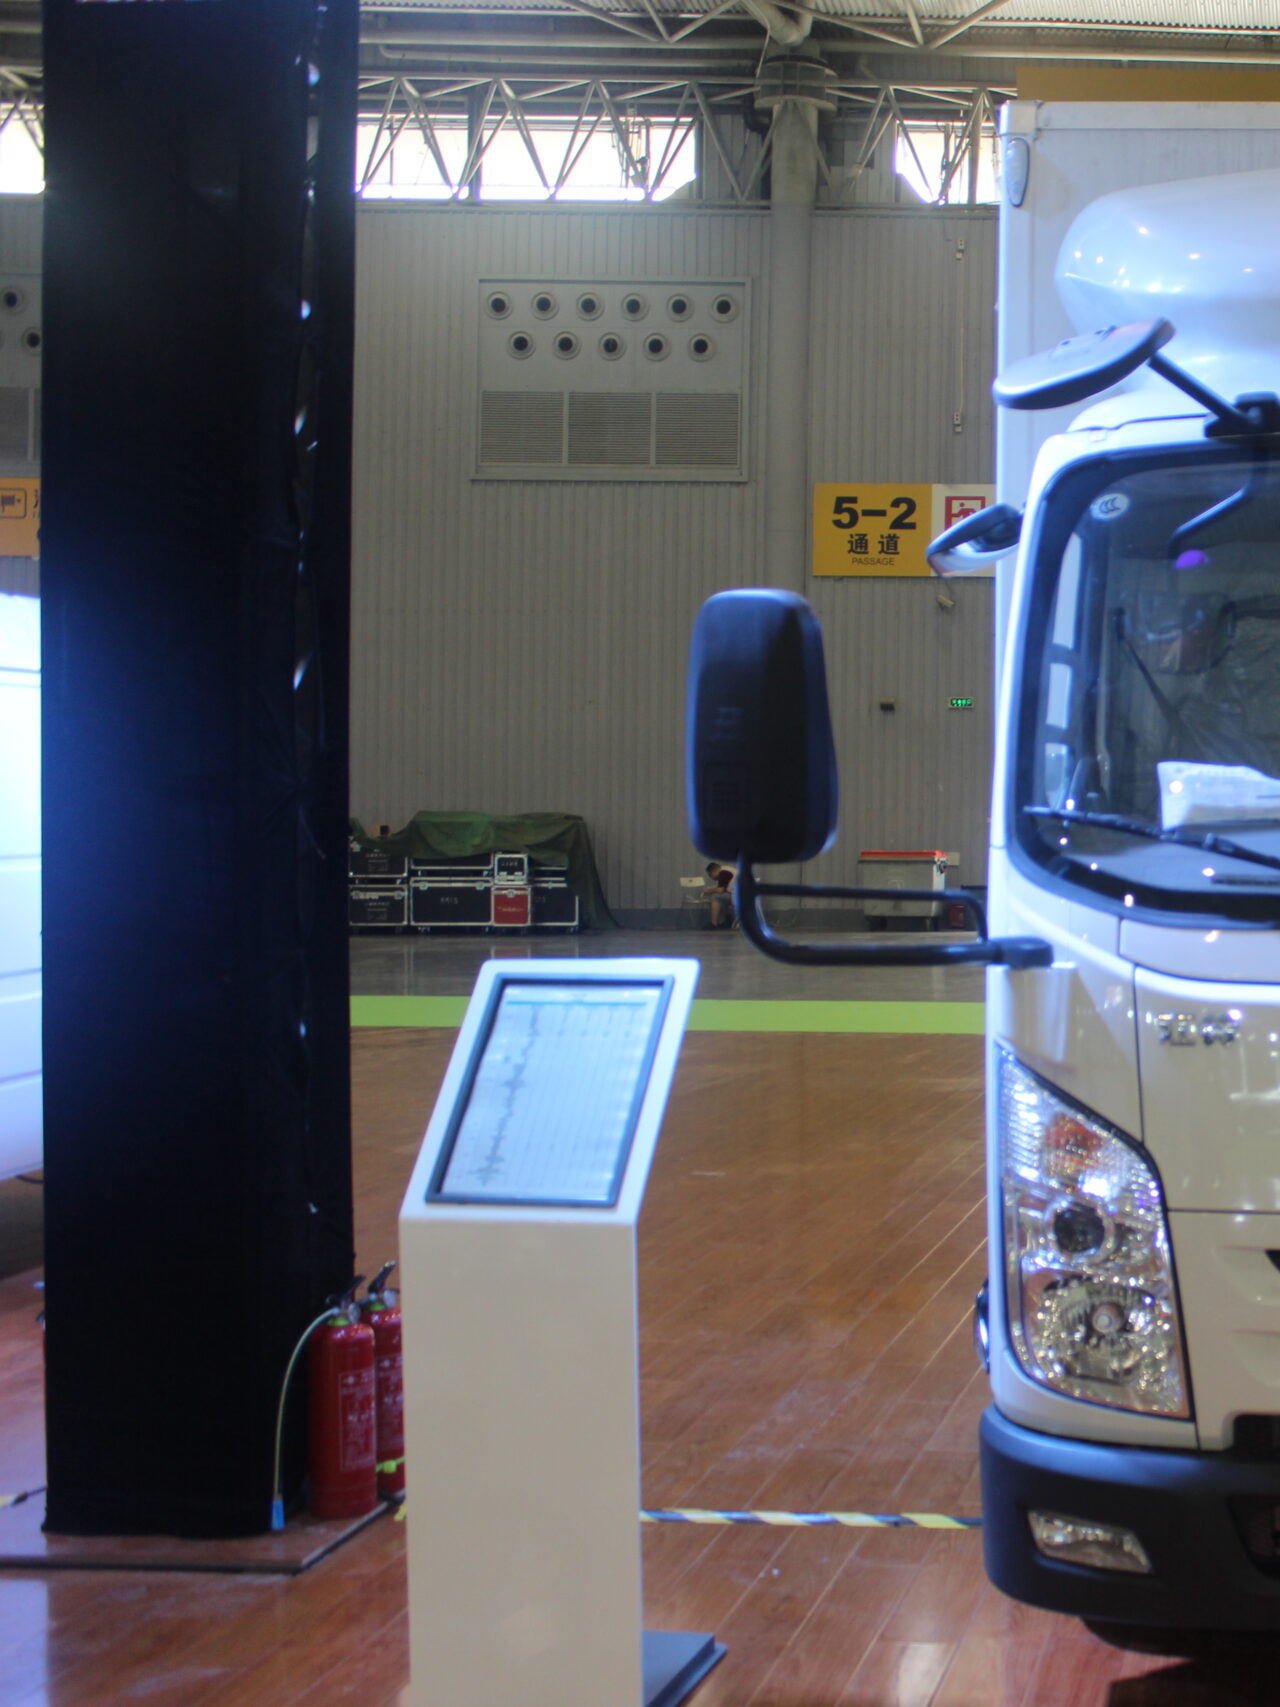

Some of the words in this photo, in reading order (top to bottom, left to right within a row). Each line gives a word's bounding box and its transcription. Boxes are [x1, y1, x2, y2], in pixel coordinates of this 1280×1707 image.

[832, 496, 917, 530] 5-2
[847, 533, 900, 555] 通道
[851, 557, 895, 566] PASSAGE
